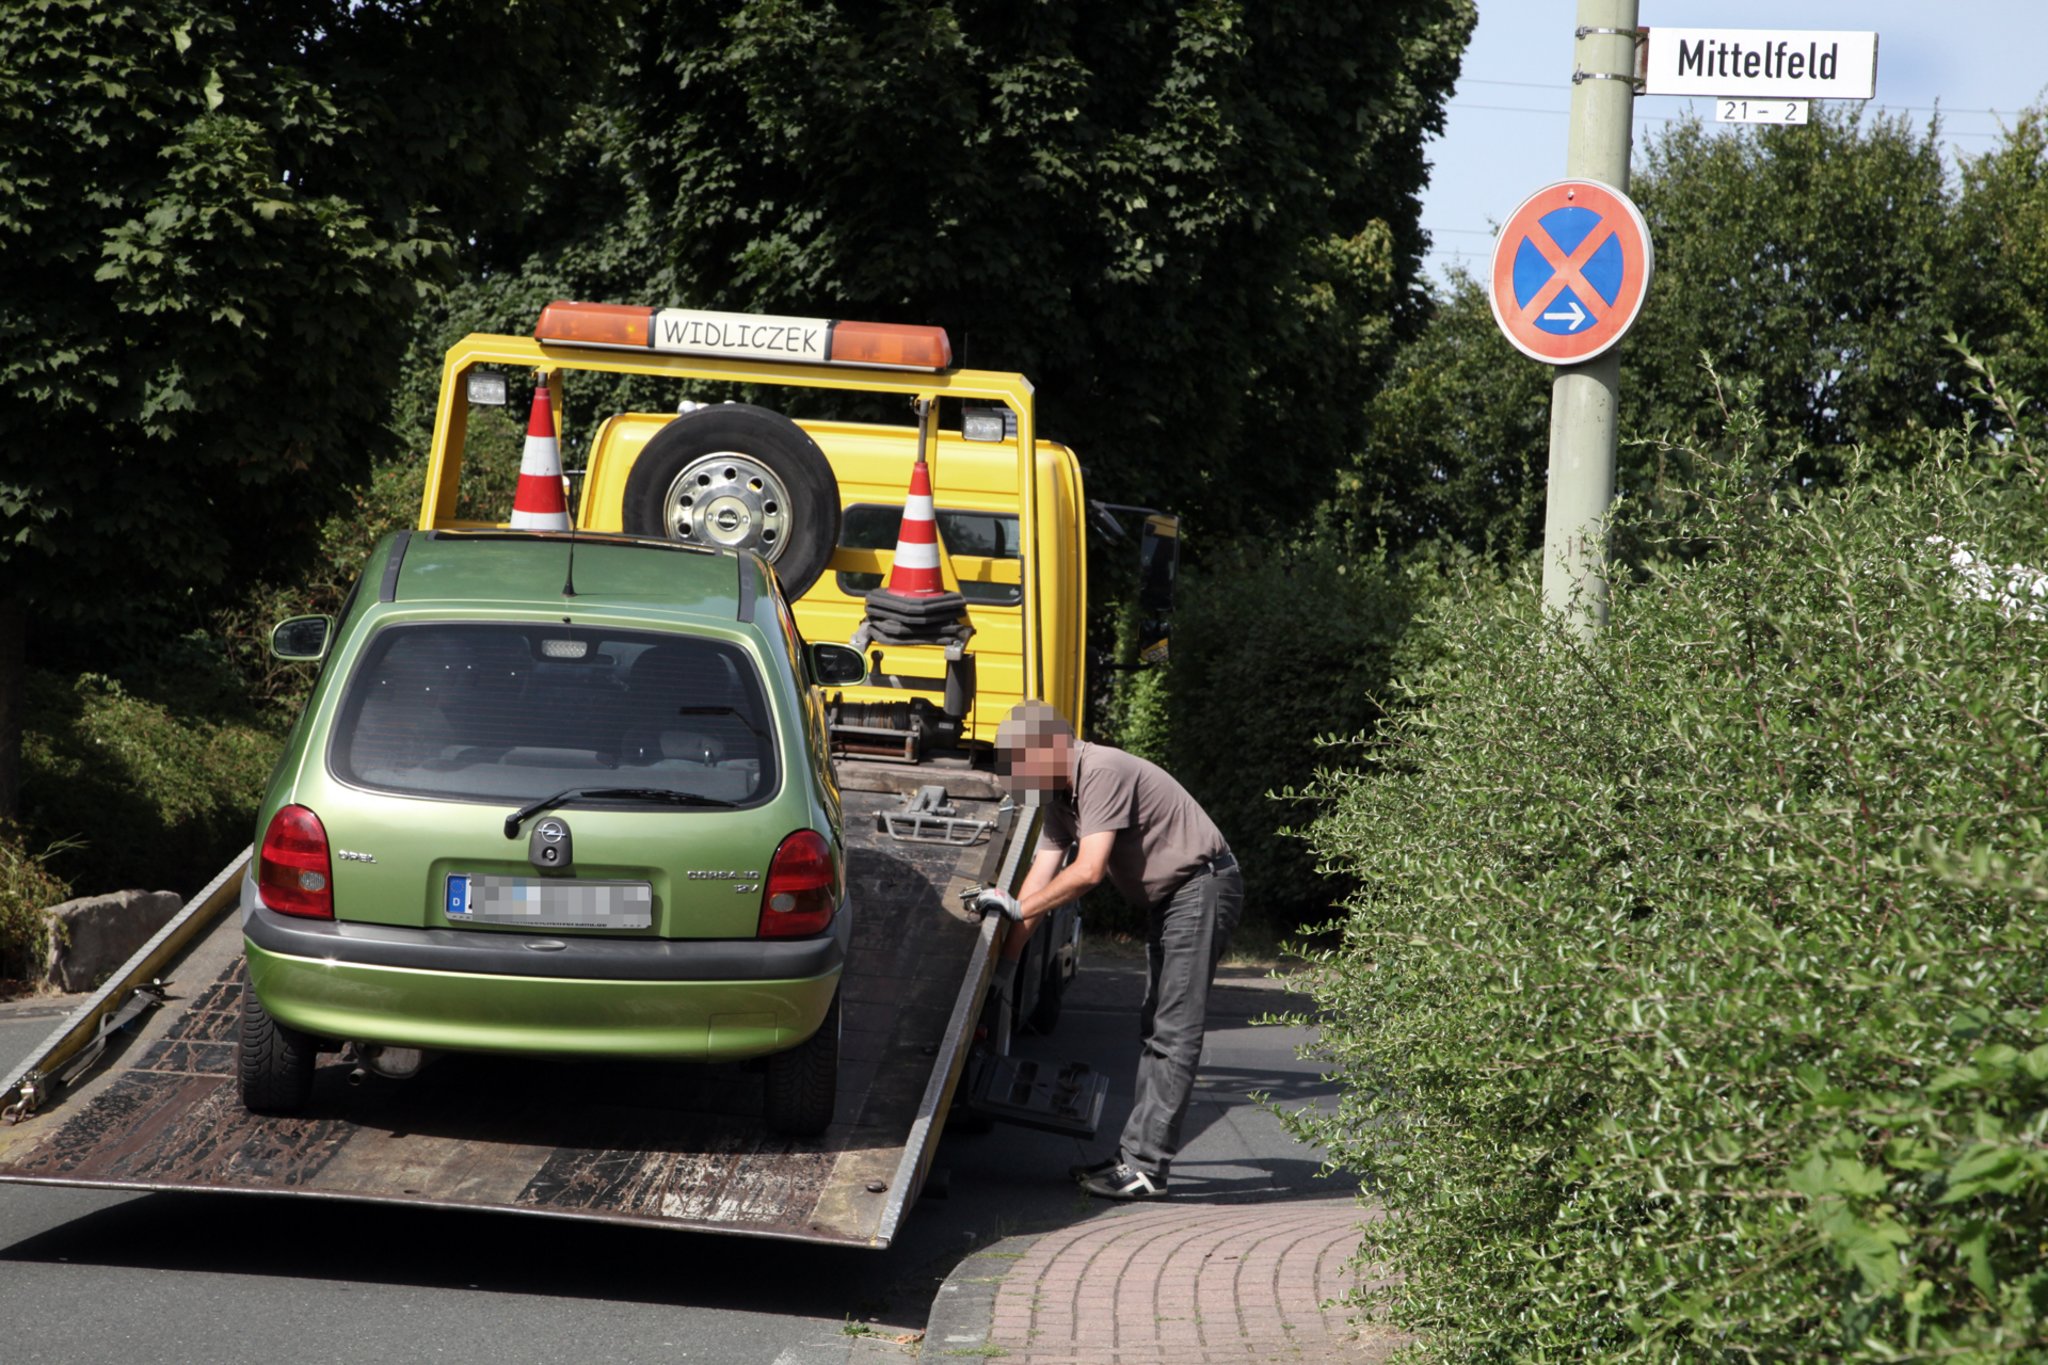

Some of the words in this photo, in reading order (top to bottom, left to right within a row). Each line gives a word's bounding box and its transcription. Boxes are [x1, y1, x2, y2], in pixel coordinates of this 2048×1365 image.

[1678, 39, 1838, 80] Mittelfeld
[1724, 101, 1748, 120] 21
[1785, 102, 1797, 121] 2
[664, 319, 818, 353] WIDLICZEK
[338, 849, 377, 864] OPEL
[687, 870, 736, 880] CORSA
[452, 897, 461, 907] D
